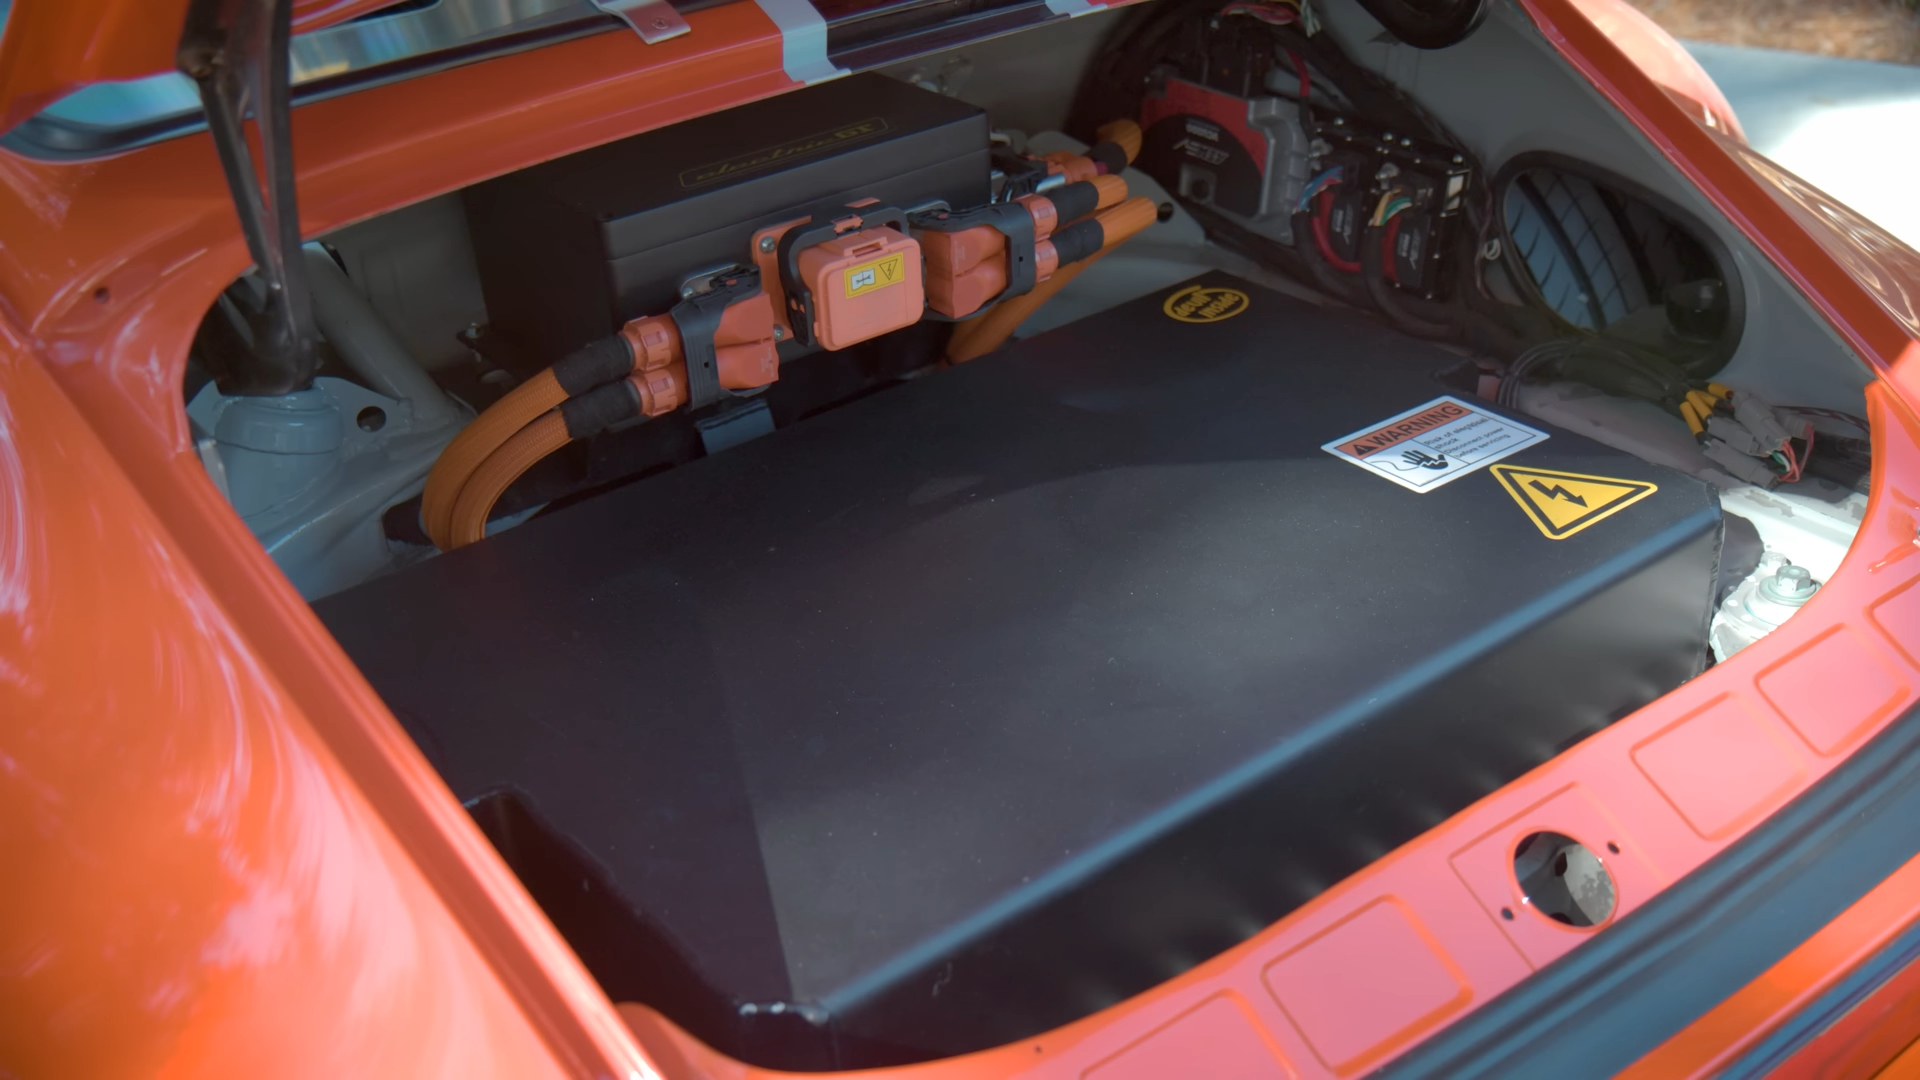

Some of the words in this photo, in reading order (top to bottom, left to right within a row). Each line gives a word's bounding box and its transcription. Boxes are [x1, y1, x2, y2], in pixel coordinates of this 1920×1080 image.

[1198, 292, 1240, 319] inside
[1365, 405, 1464, 447] WARNING
[1423, 435, 1442, 446] Risk
[1443, 430, 1454, 438] of
[1452, 417, 1490, 434] electrical
[1443, 435, 1485, 454] Disconnect
[1482, 427, 1505, 438] power
[1454, 446, 1479, 459] before
